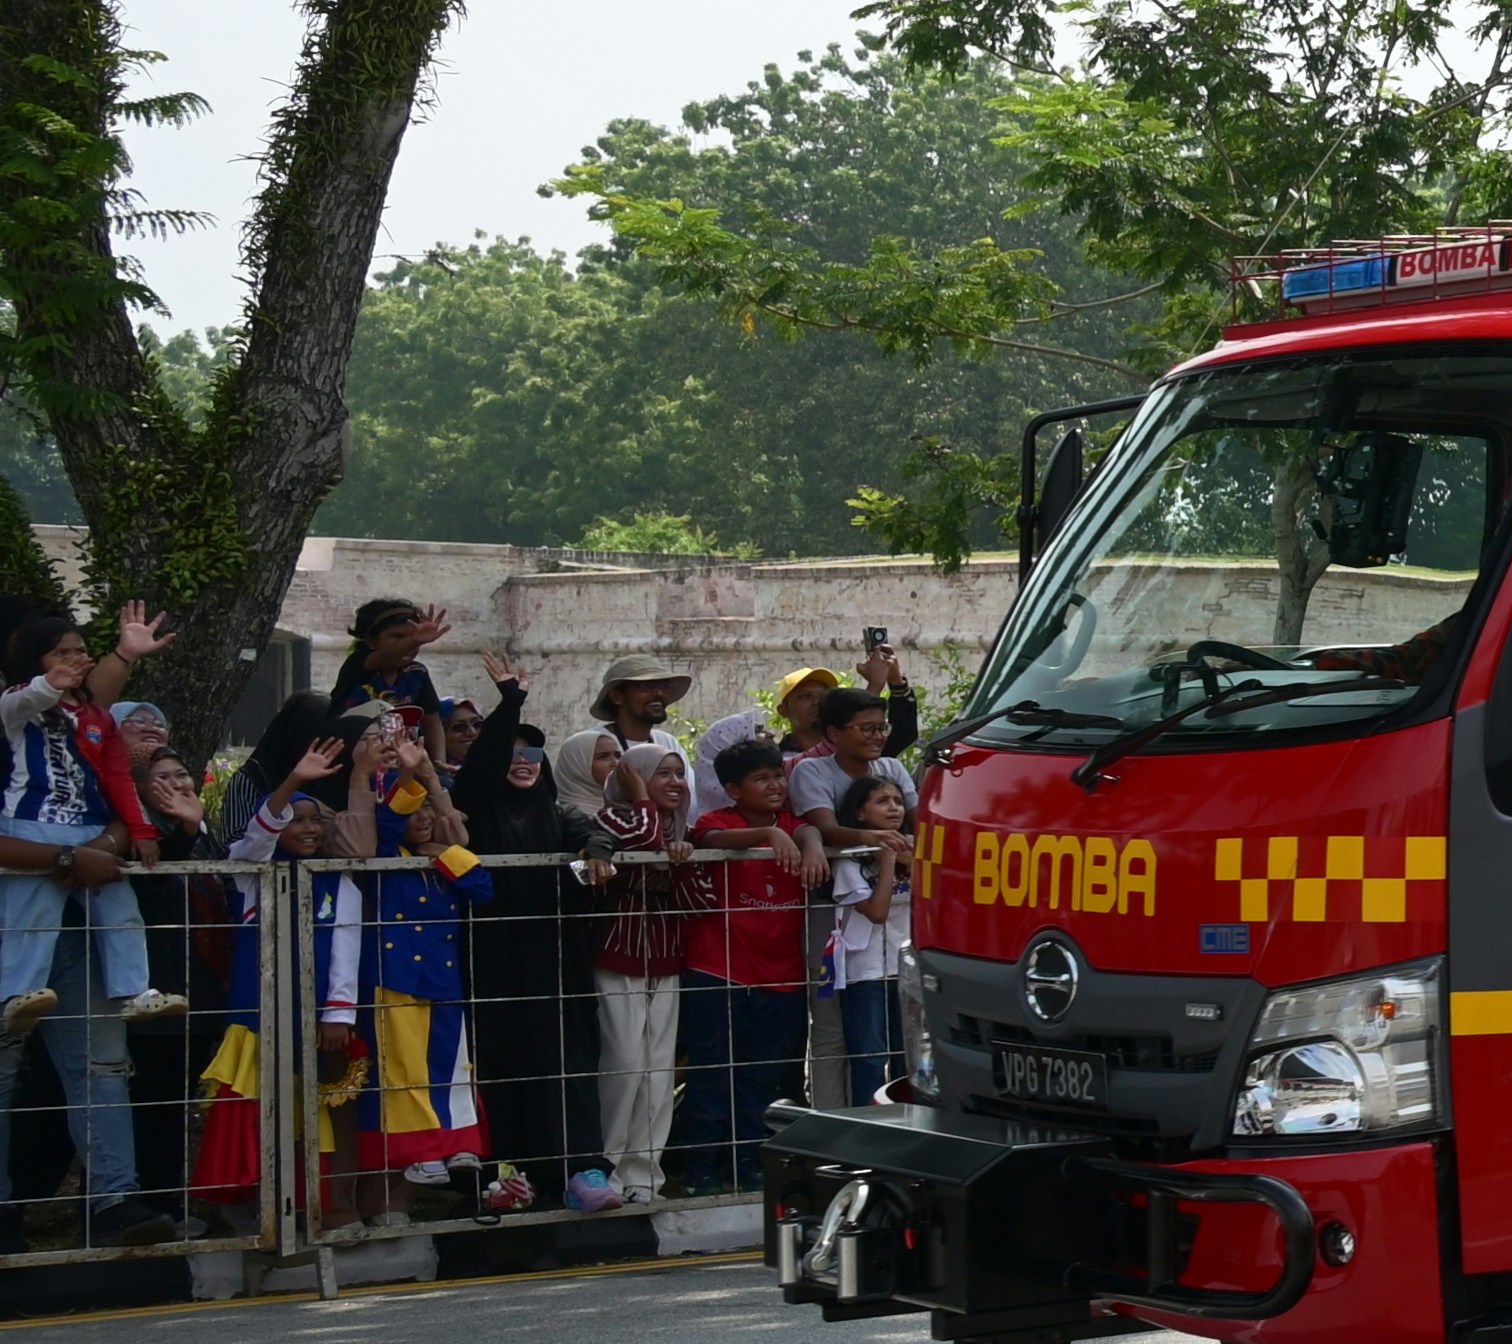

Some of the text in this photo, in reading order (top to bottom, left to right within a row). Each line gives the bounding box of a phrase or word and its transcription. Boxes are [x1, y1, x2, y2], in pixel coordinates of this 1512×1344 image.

[1400, 244, 1496, 278] BOMBA
[974, 832, 1157, 917] BOMBA
[1001, 1051, 1095, 1100] VPG 7382
